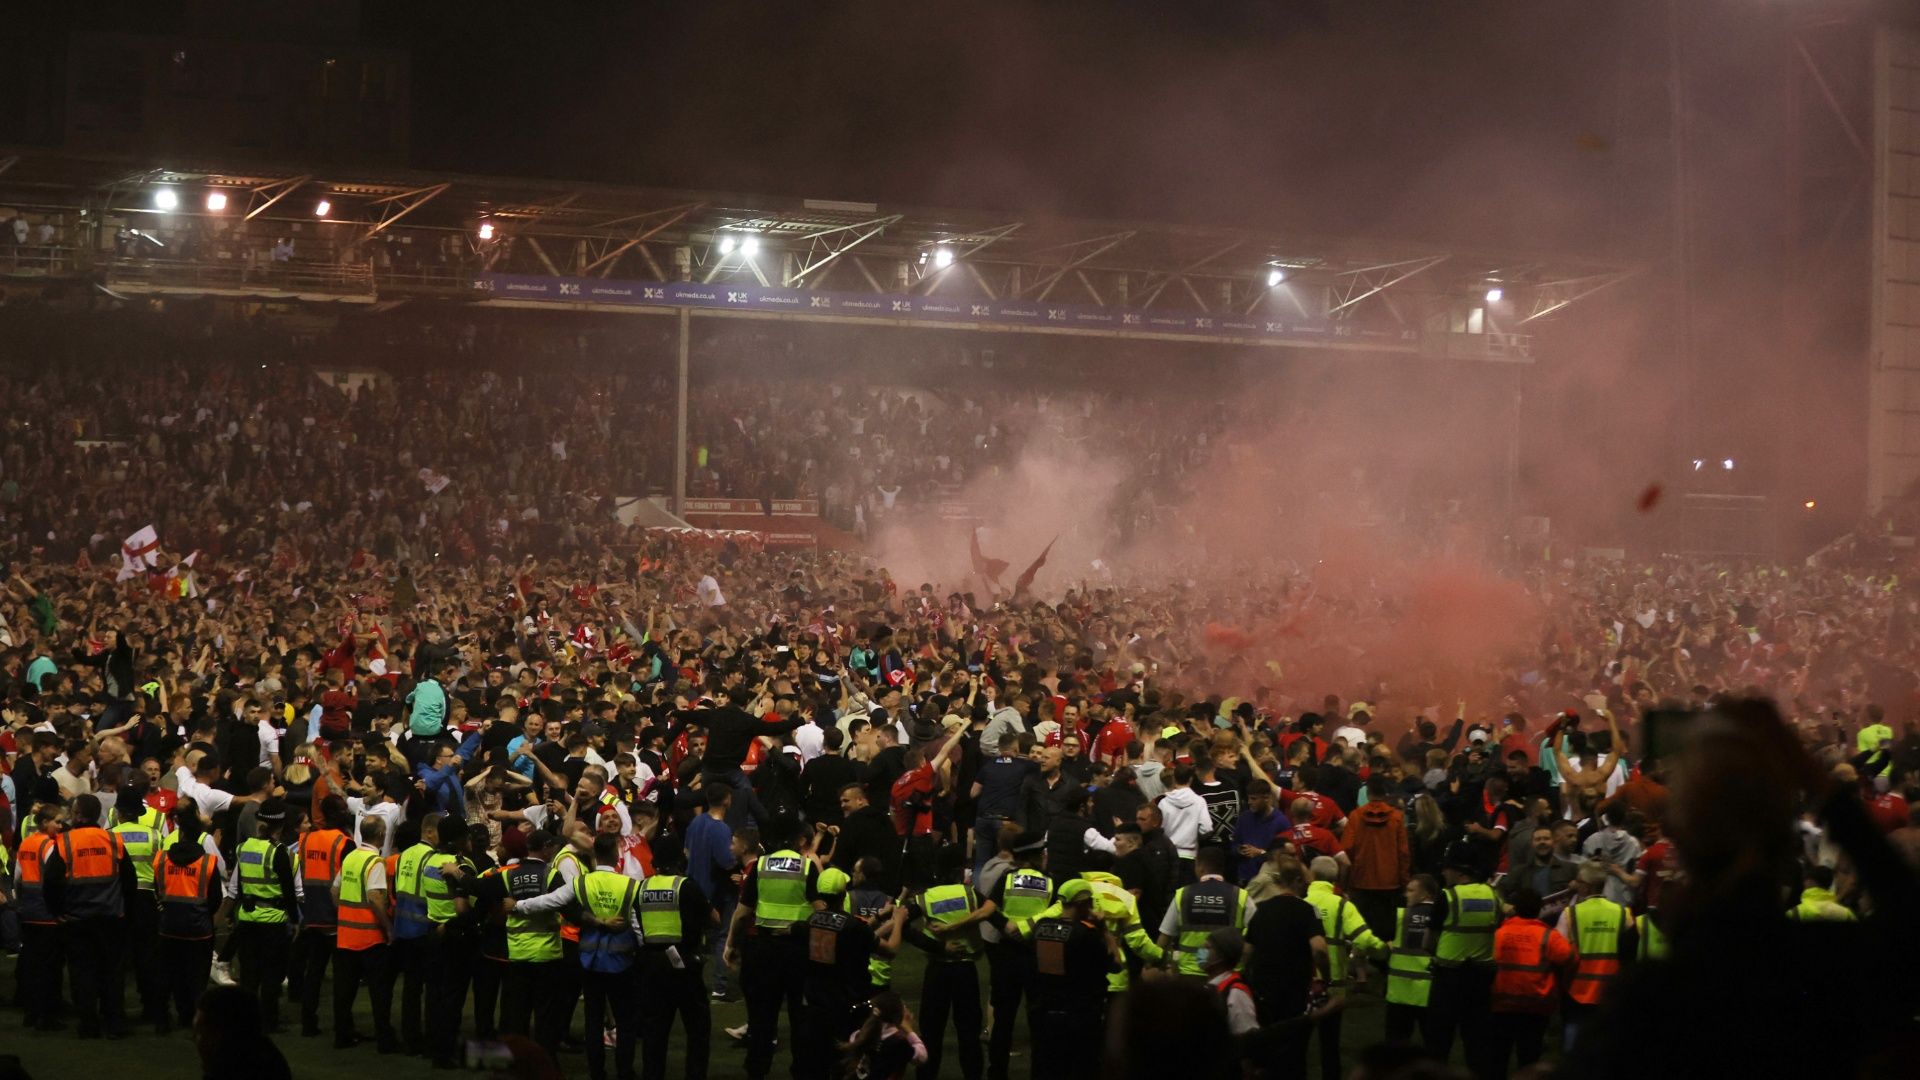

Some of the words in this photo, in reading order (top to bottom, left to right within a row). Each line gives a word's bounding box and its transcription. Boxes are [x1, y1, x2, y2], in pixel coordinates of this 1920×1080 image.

[675, 291, 716, 300] ukmeds.co.uk
[759, 295, 799, 304] ukmeds.co.uk
[696, 502, 714, 510] FAMILY
[1015, 876, 1046, 890] OLICE
[643, 890, 674, 902] POLICE
